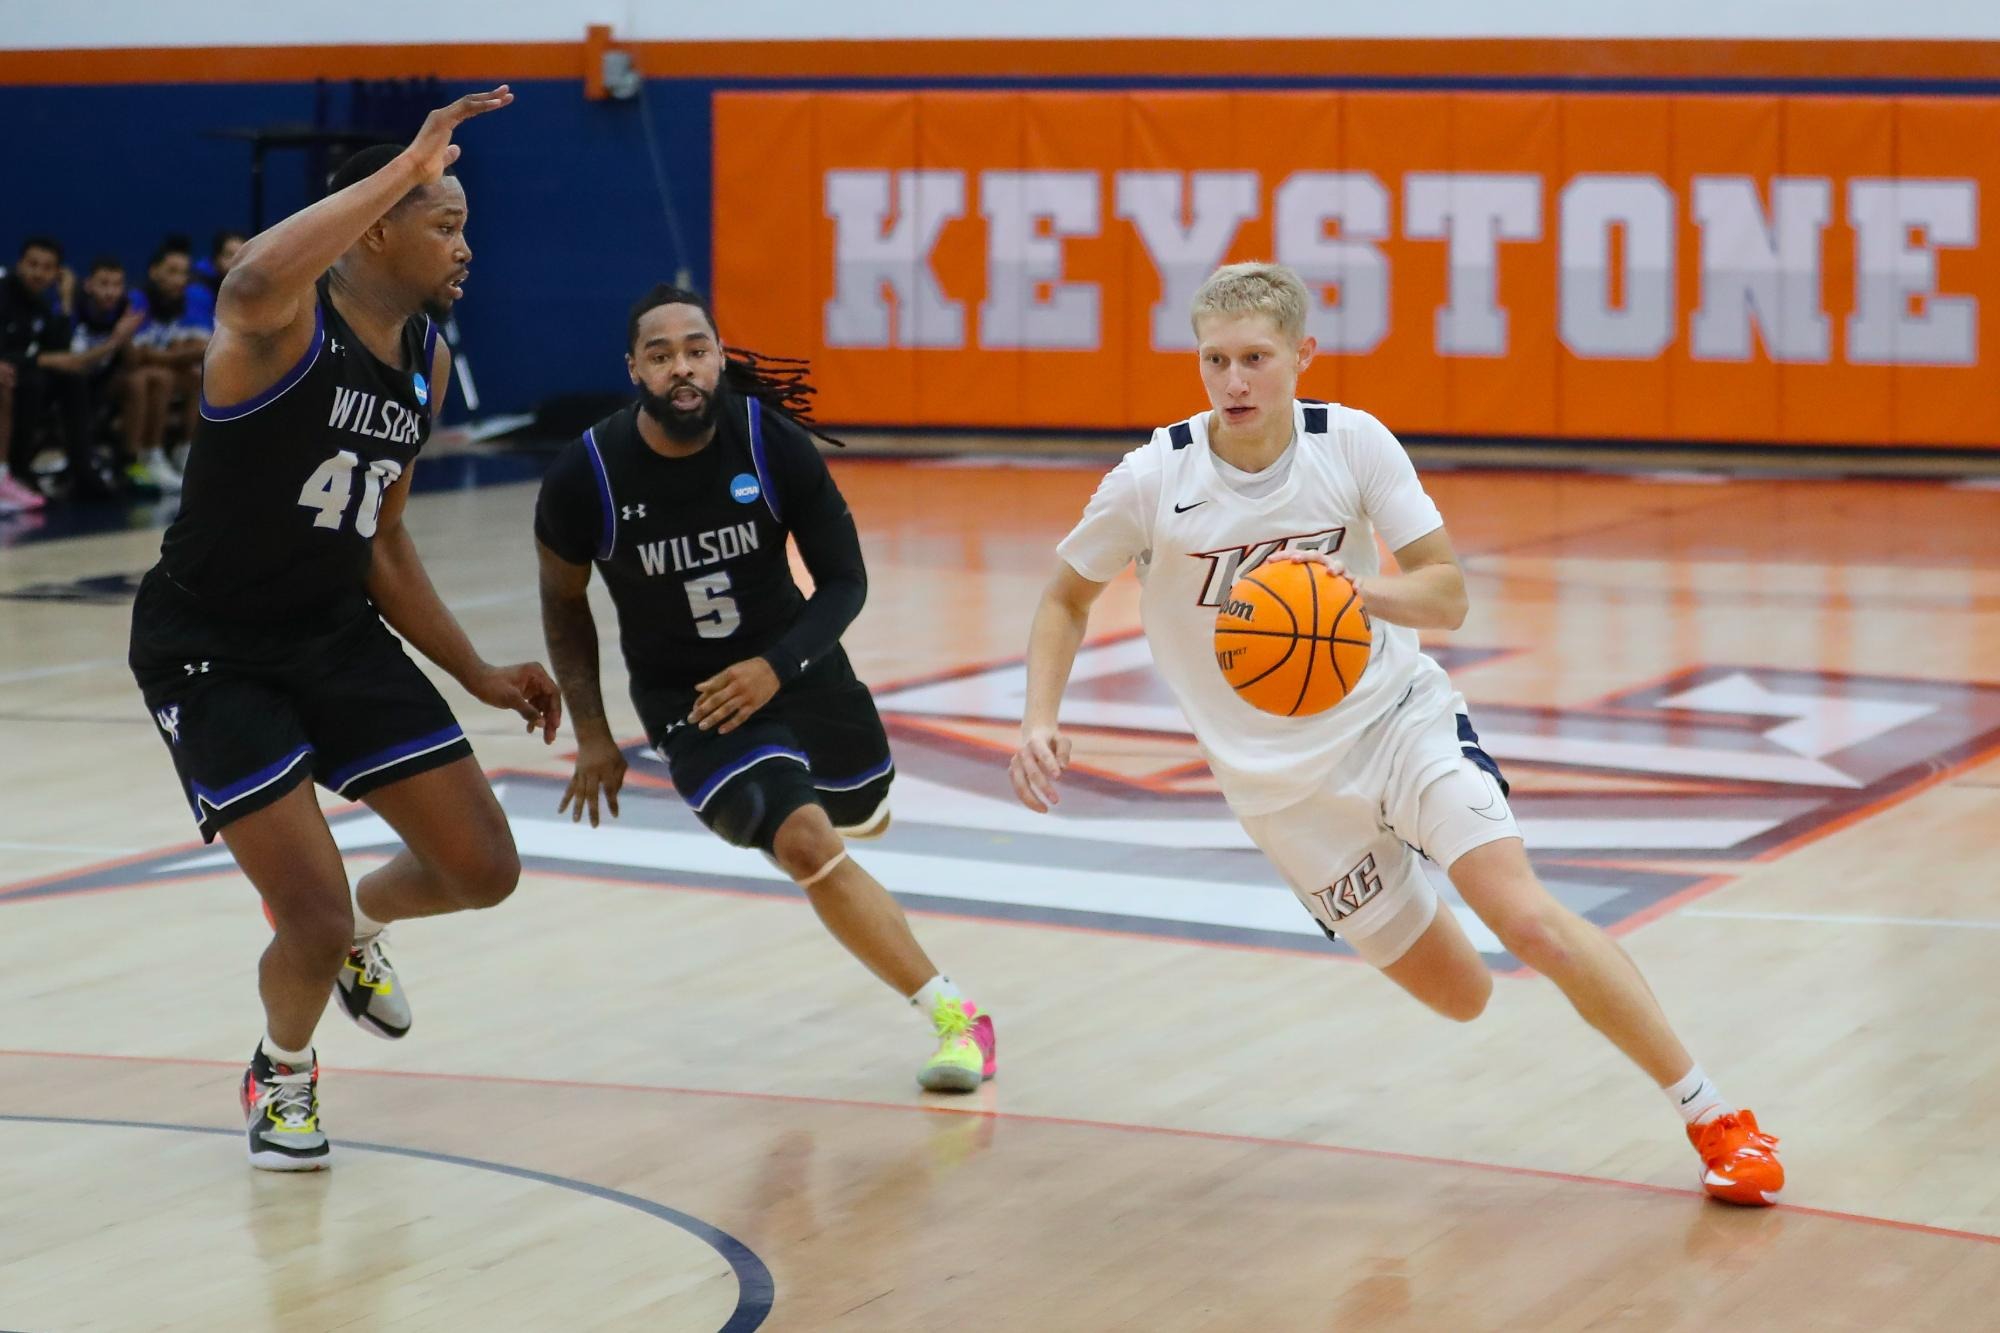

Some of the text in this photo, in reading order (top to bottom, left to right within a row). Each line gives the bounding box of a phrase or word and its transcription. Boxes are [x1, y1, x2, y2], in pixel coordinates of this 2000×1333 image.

[824, 169, 1978, 366] KEYSTONE
[328, 386, 421, 444] WILSON
[297, 450, 402, 538] 40
[637, 521, 759, 576] WILSON
[684, 571, 740, 638] 5
[1312, 852, 1383, 922] KC
